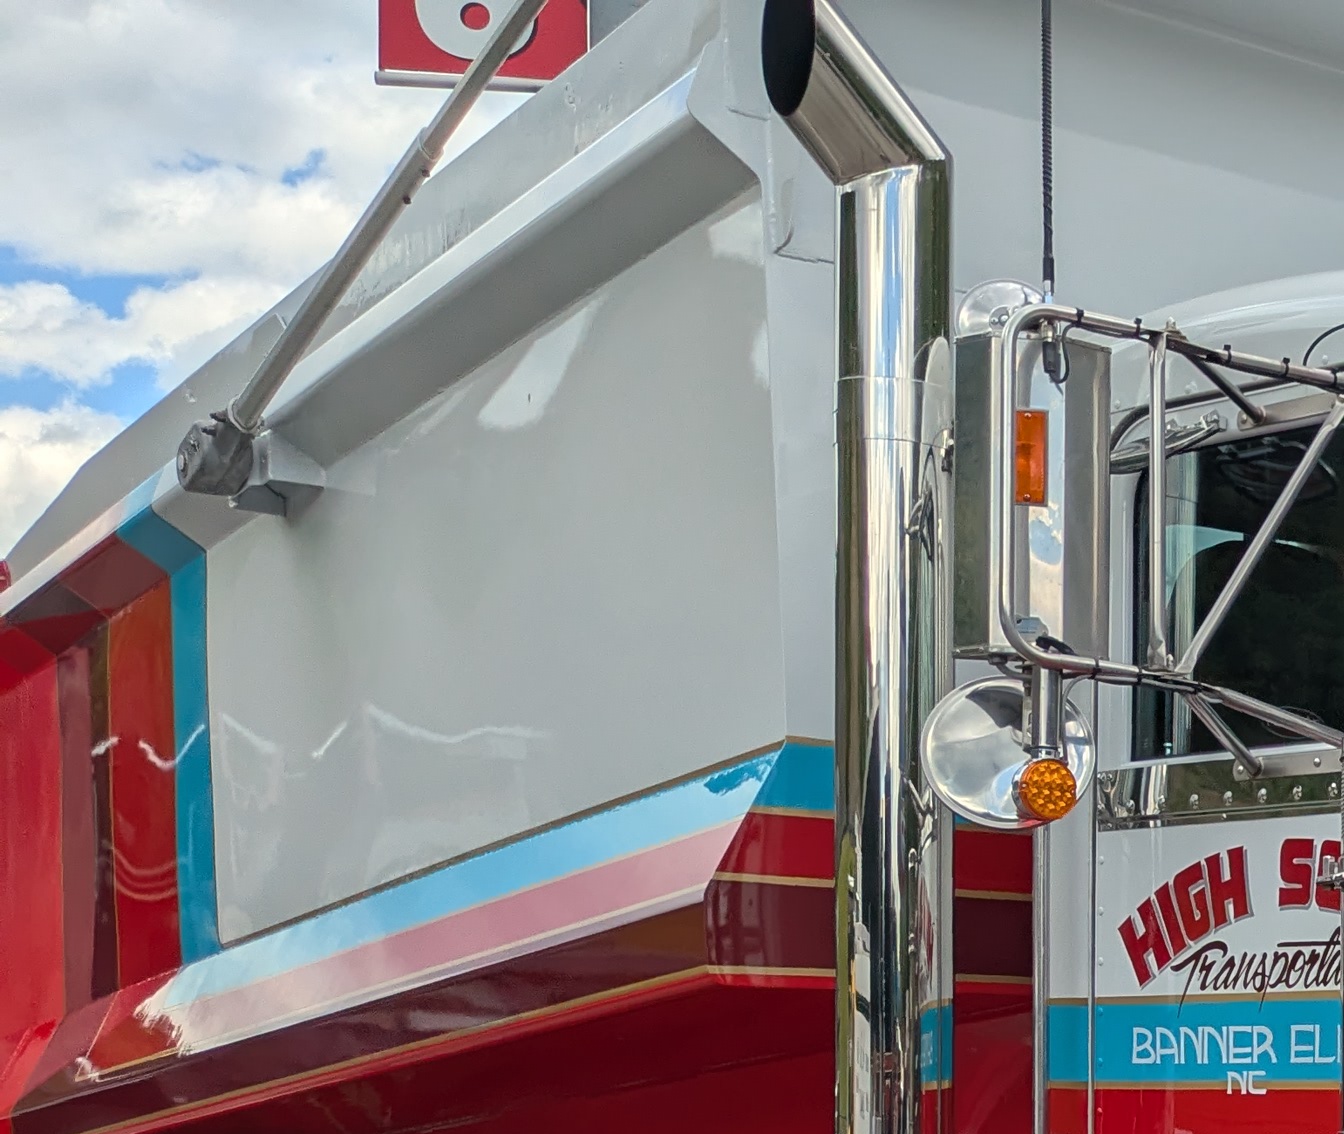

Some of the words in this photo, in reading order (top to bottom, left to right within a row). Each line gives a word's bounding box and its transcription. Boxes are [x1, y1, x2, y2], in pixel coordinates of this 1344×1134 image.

[1117, 845, 1255, 989] HIGH
[1131, 1025, 1278, 1065] BANNER
[1289, 1023, 1341, 1064] EL
[1226, 1070, 1268, 1095] NC
